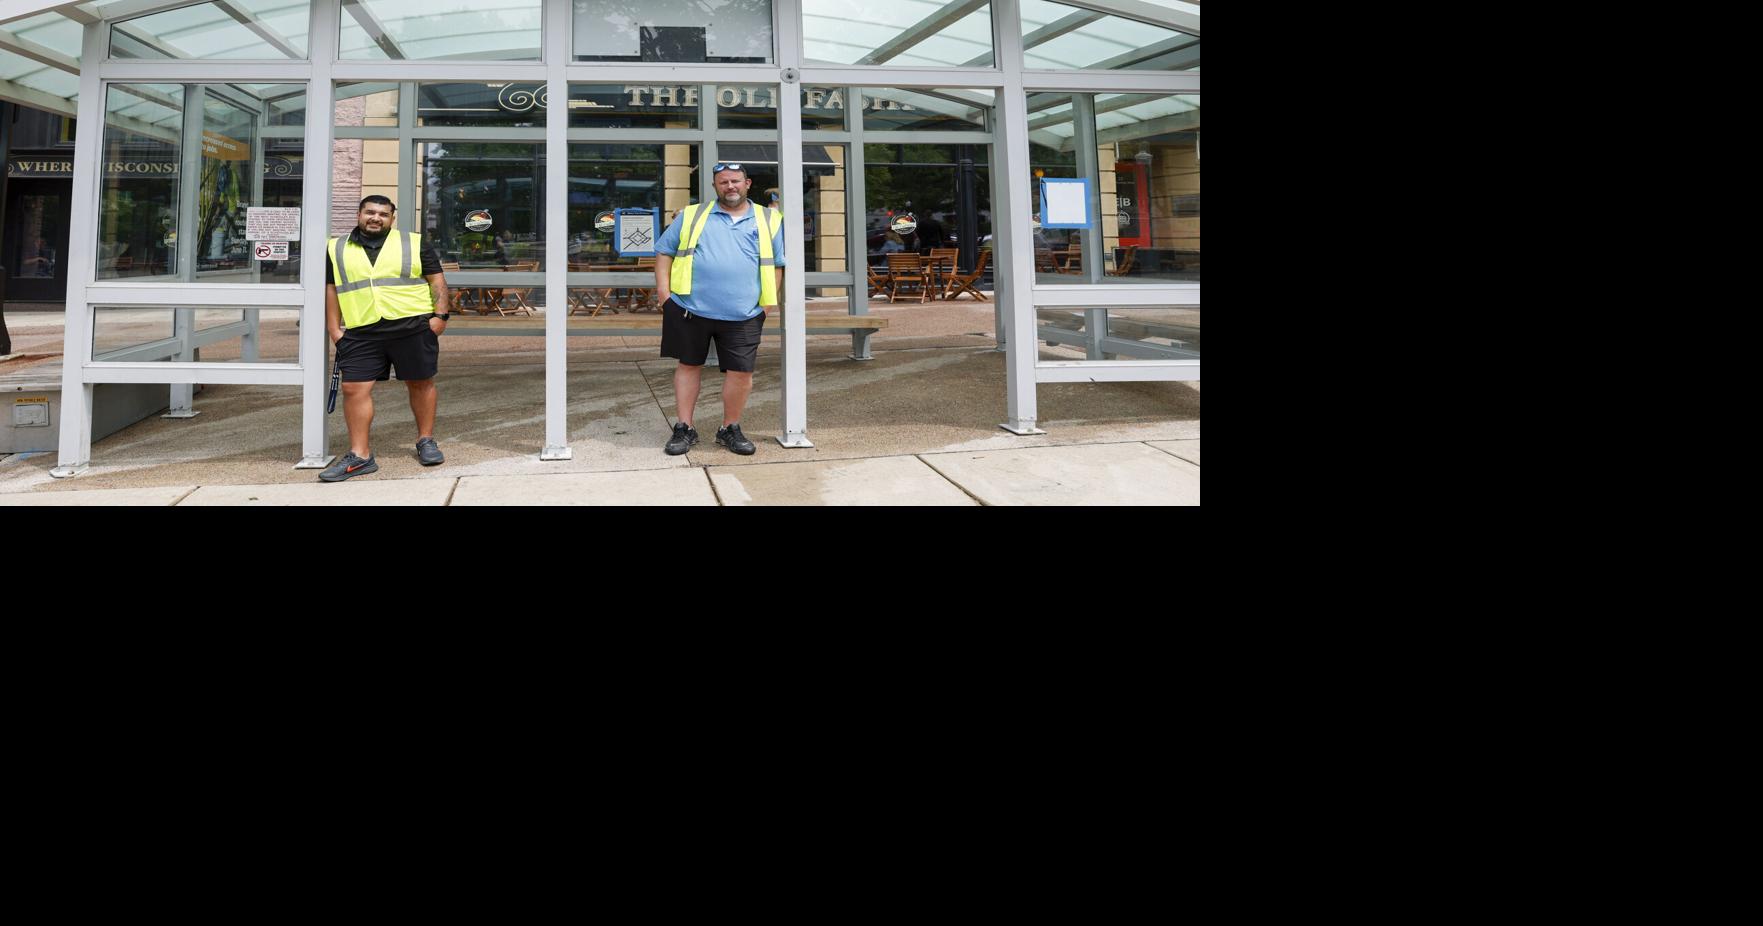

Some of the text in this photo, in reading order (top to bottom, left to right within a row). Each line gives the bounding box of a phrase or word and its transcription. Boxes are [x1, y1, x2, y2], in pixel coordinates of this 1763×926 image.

[624, 85, 698, 107] THE
[17, 161, 179, 174] WHER ISCONSI
